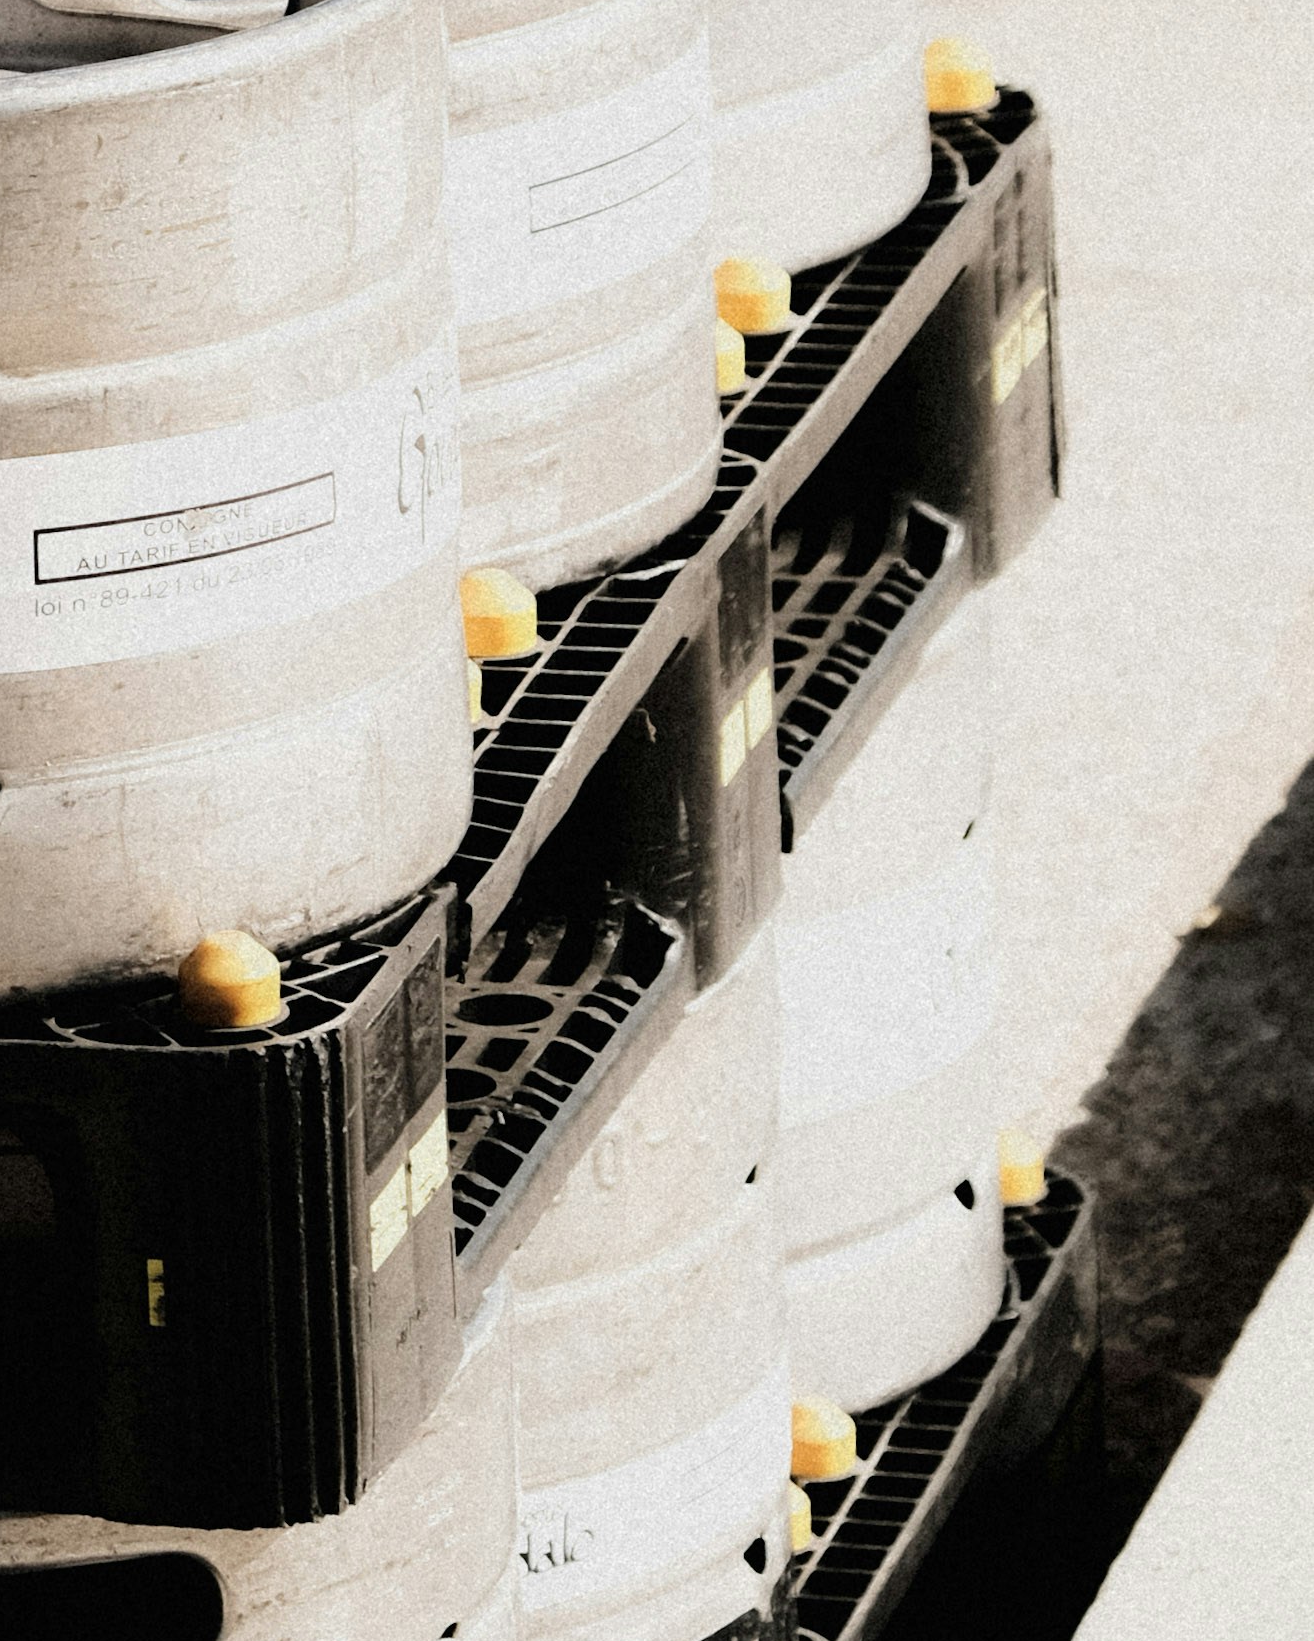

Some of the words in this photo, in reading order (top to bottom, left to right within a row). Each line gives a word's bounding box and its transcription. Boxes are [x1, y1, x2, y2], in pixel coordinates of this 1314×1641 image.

[75, 554, 108, 574] AU
[119, 542, 179, 567] TARIF
[34, 598, 63, 618] loi
